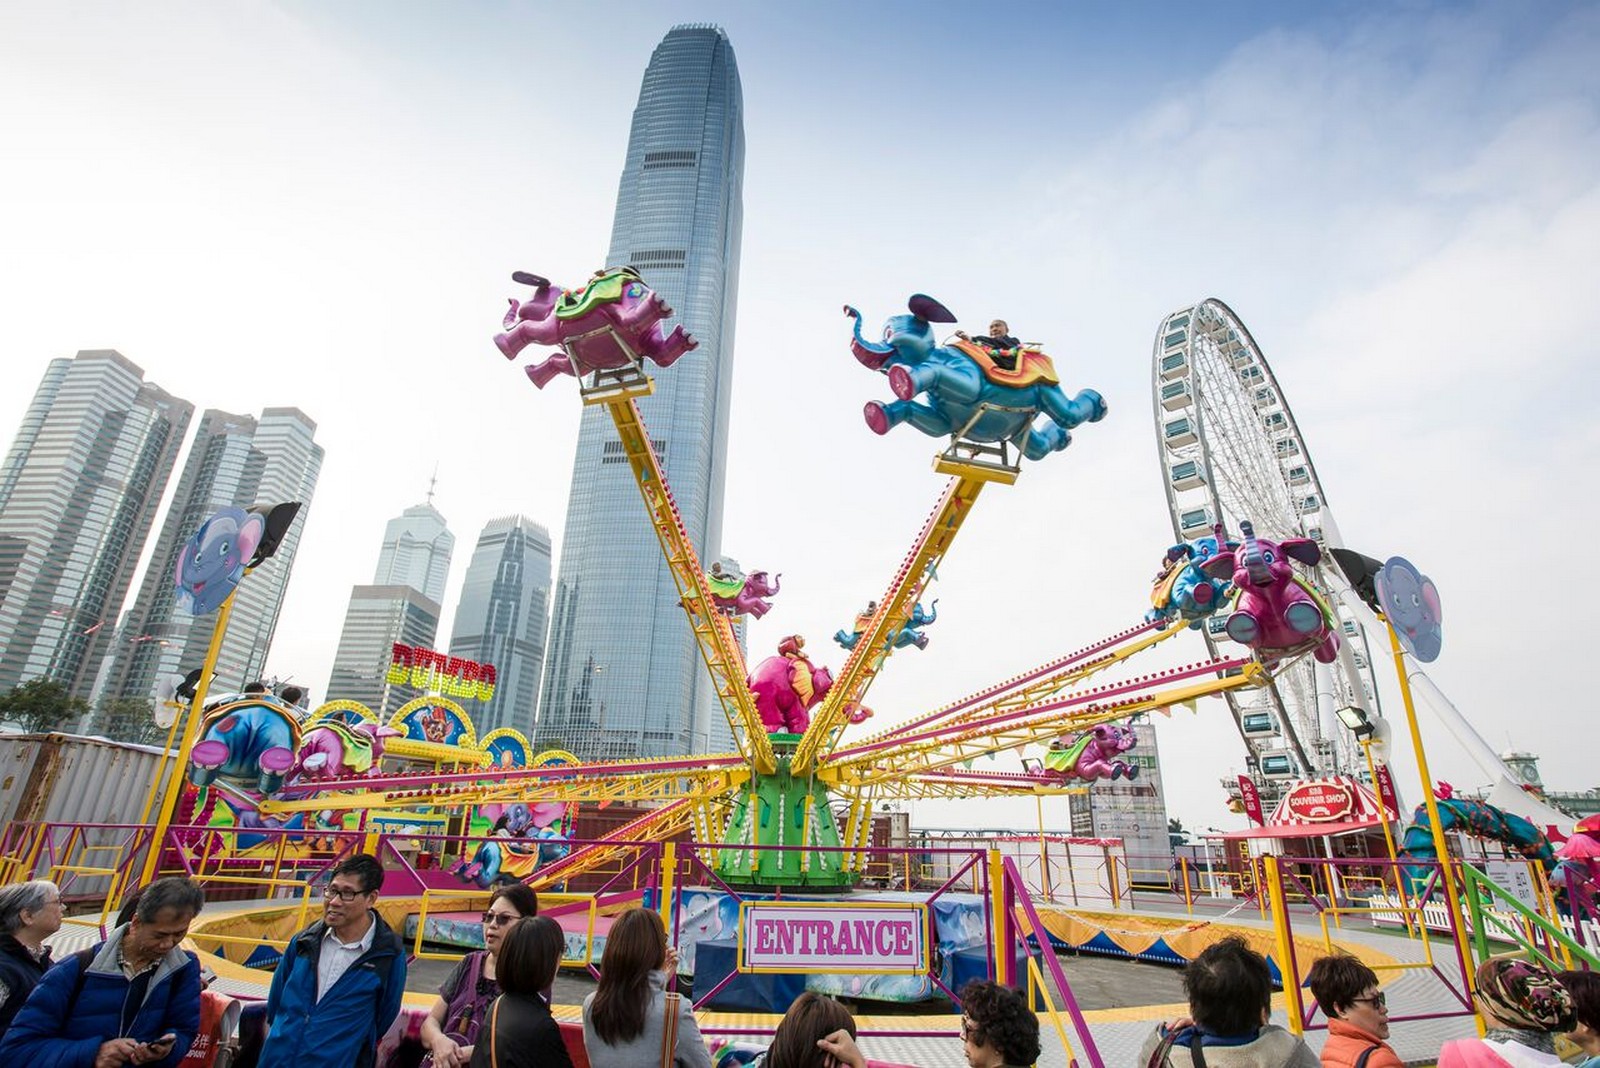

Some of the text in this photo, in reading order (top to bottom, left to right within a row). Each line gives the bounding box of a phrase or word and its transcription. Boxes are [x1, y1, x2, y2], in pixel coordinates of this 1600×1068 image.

[386, 640, 497, 702] DUMBO
[1290, 793, 1346, 806] SOUVENIR SHOP
[754, 919, 913, 956] ENTRANCE
